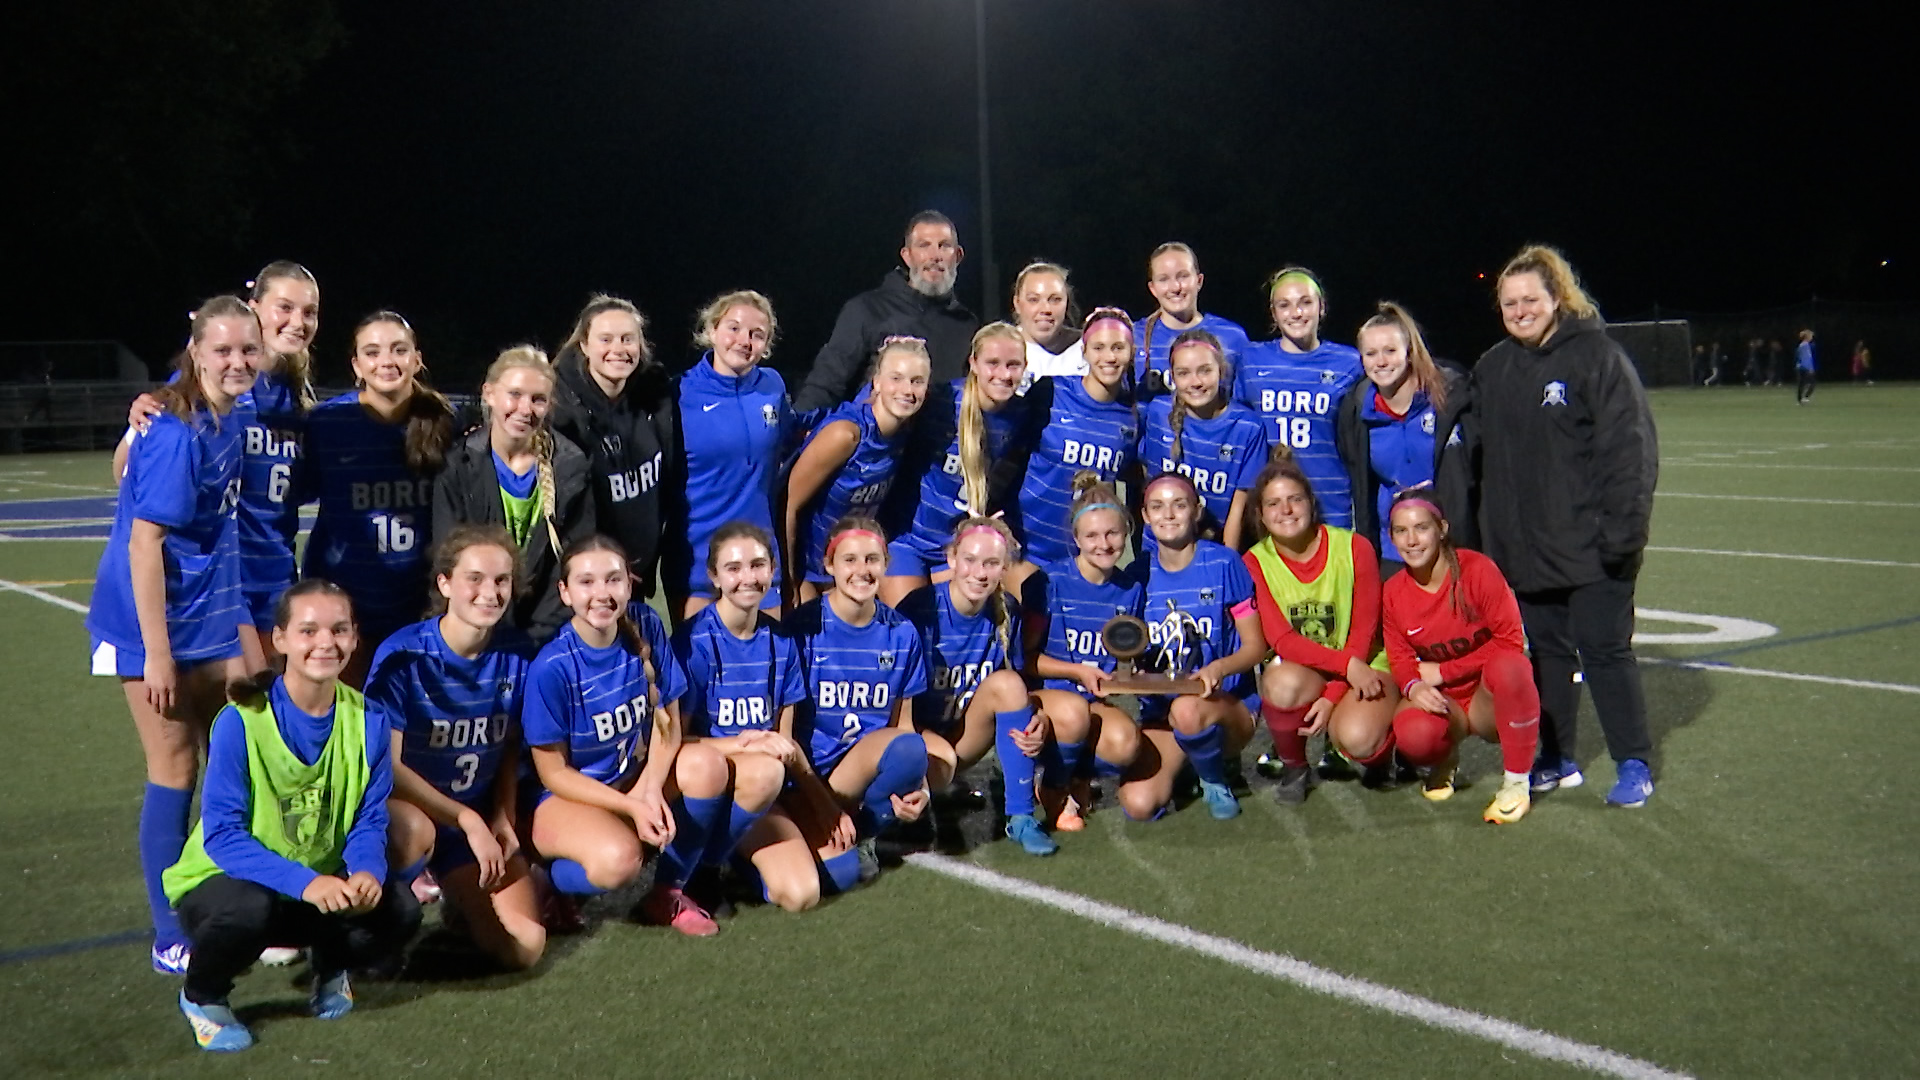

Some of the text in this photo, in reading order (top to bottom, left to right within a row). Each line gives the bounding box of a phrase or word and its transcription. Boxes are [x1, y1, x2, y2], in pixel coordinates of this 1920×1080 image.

[1261, 390, 1330, 415] BORO
[1275, 417, 1311, 449] 18
[267, 463, 292, 503] 6
[372, 515, 415, 554] 16
[819, 681, 889, 708] BORO
[429, 714, 508, 749] BORO
[843, 714, 868, 745] 2
[451, 754, 480, 792] 3
